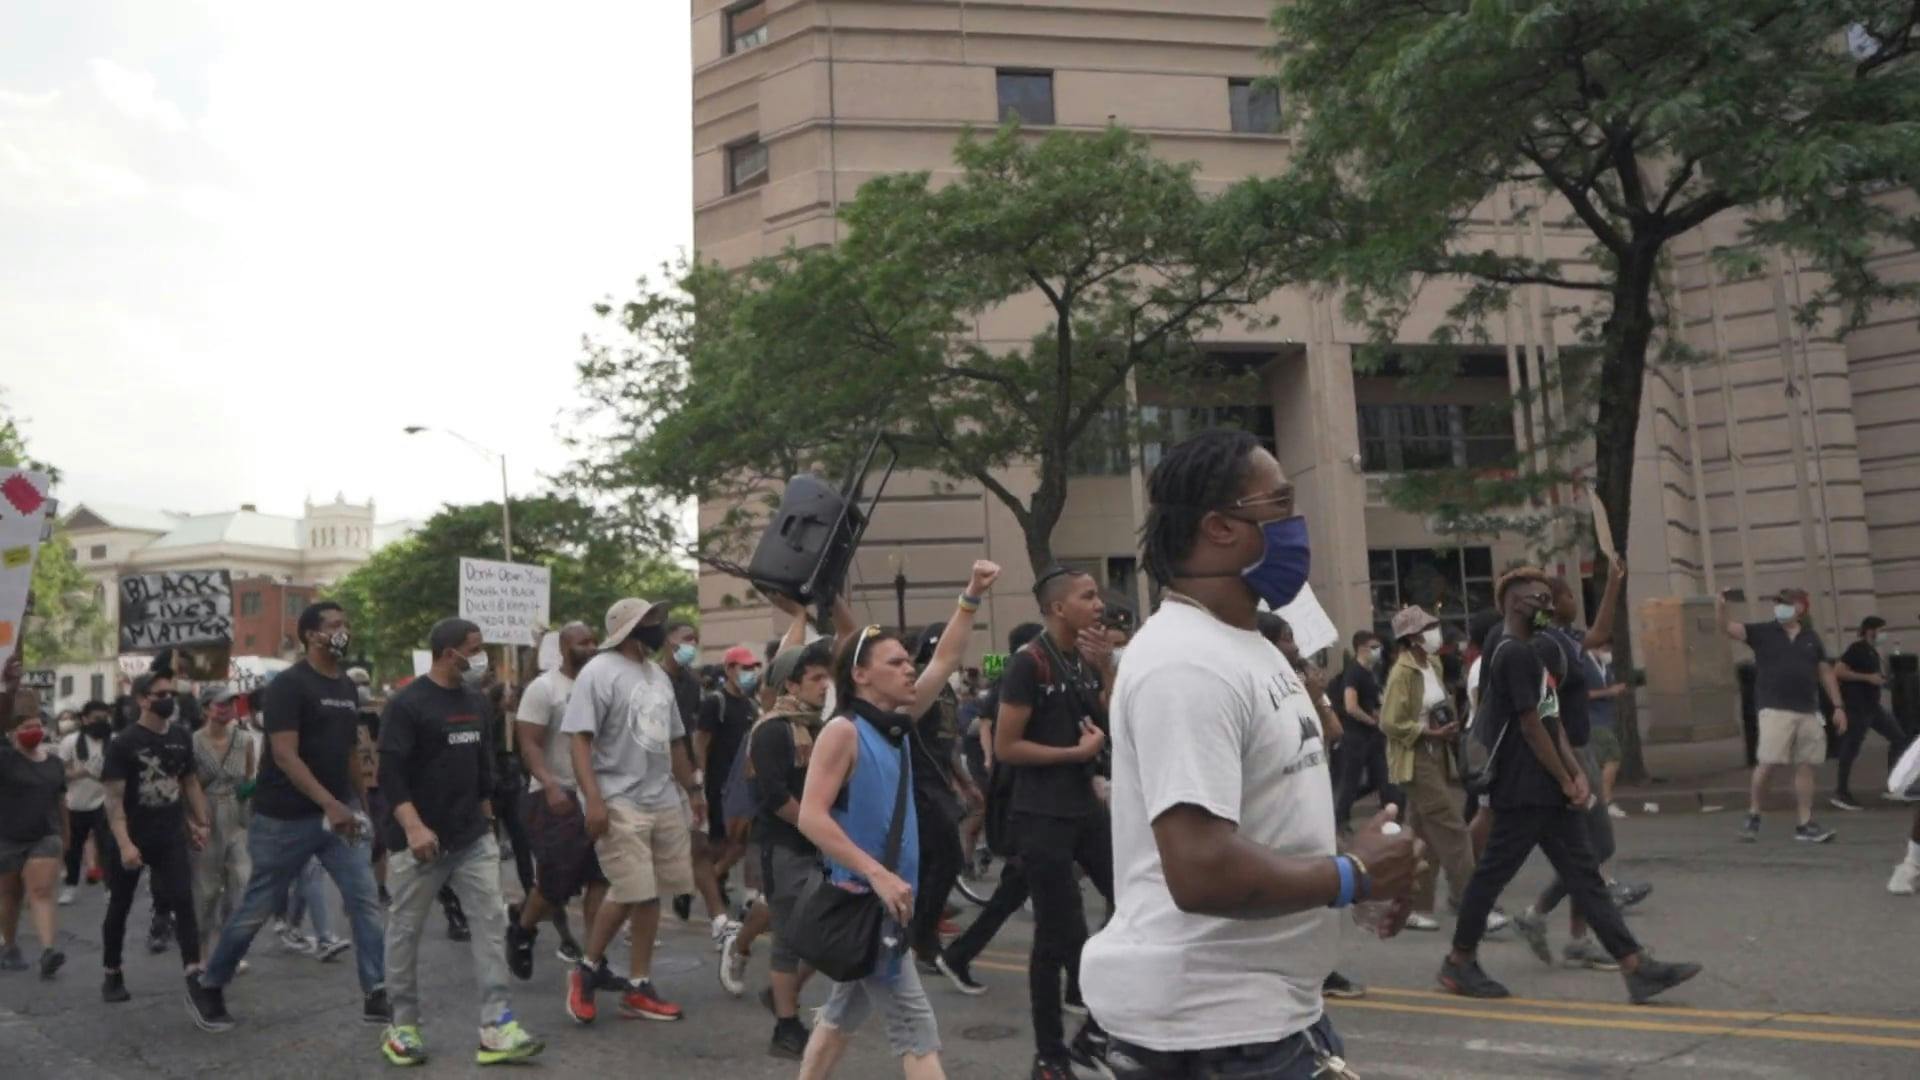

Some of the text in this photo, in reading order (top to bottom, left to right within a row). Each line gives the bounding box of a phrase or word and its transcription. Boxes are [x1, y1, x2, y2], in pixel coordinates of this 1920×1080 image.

[123, 574, 220, 602] BLACK
[140, 599, 217, 618] LIVES
[126, 616, 231, 645] MATTER
